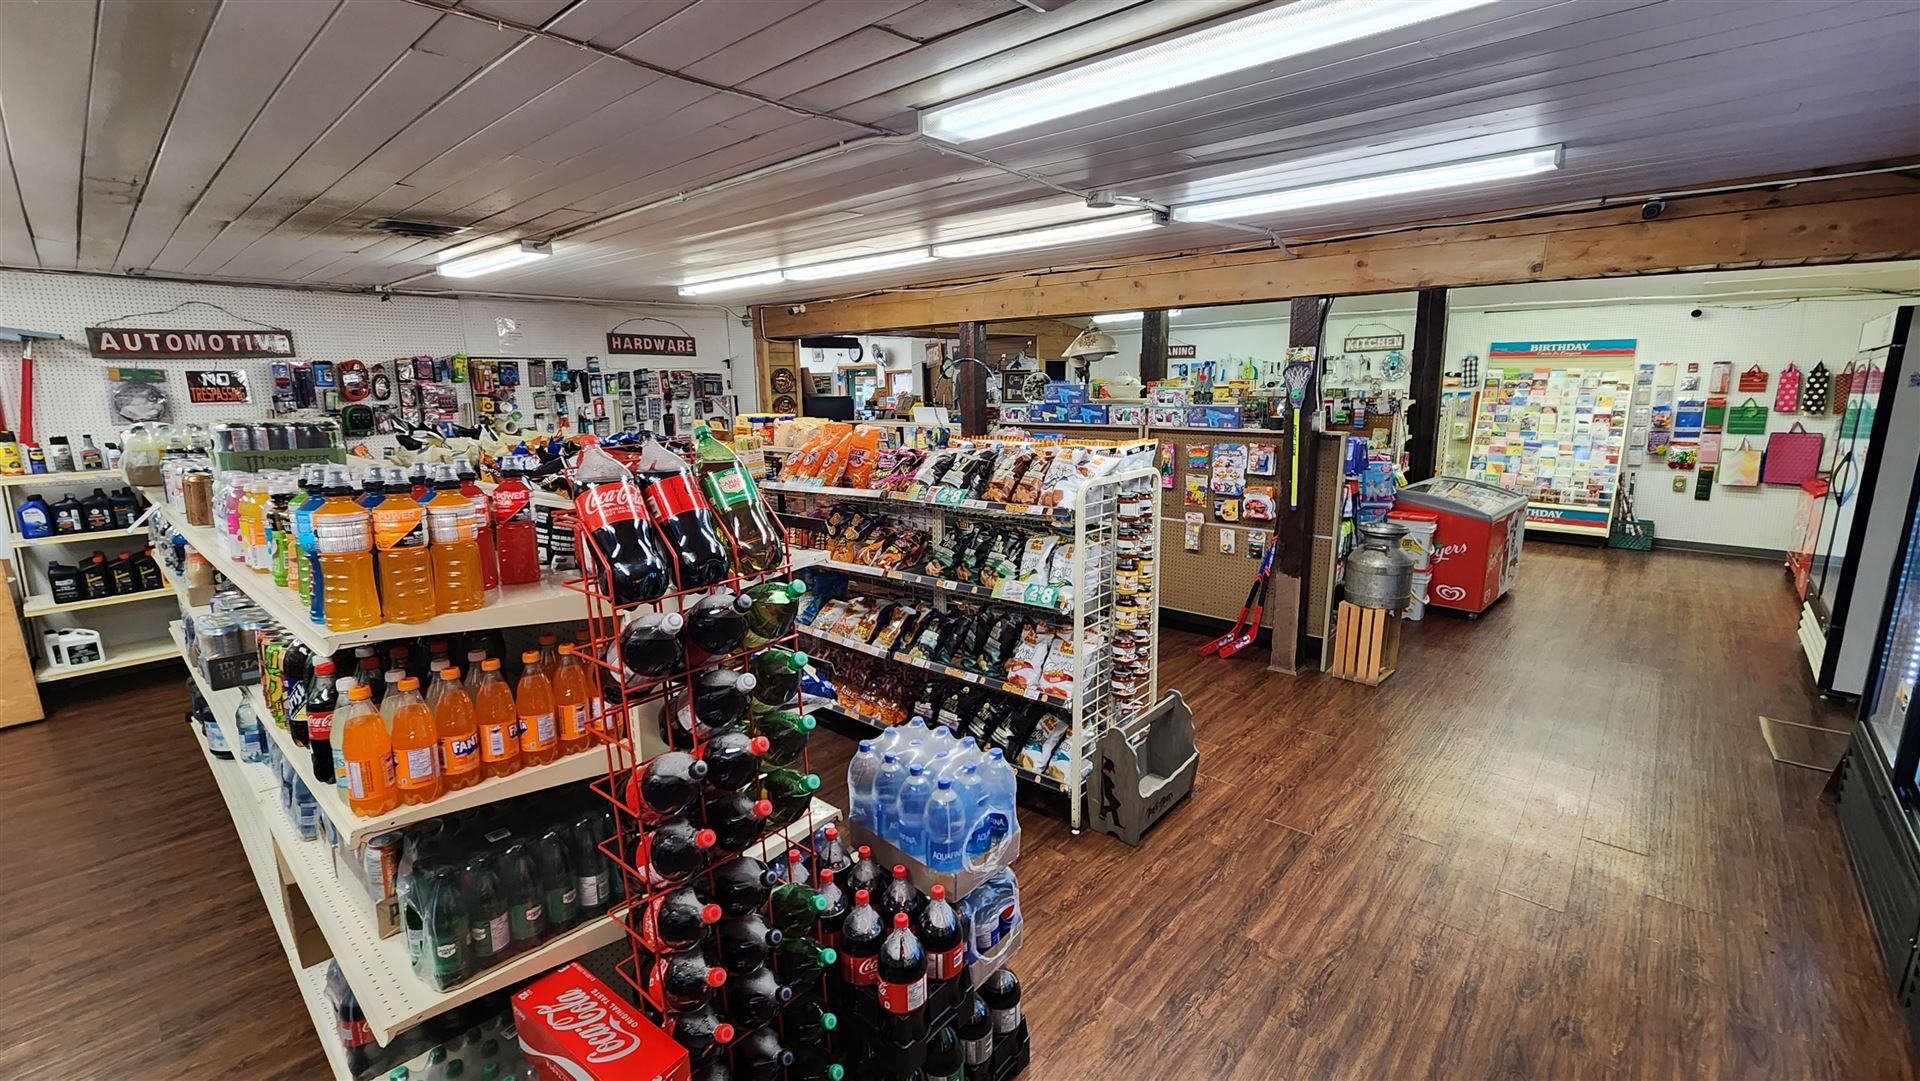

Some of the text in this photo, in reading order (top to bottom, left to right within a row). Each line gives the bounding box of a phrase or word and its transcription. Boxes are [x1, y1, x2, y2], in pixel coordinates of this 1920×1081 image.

[101, 332, 291, 354] AUTOMOTIVE
[612, 337, 694, 352] HARDWARE
[1346, 337, 1402, 351] KITCHEN
[1530, 343, 1591, 352] BIRTHDAY
[1168, 346, 1195, 356] ANING
[202, 372, 230, 386] NO
[190, 386, 246, 401] TRESPASSING
[496, 491, 526, 500] POWER
[378, 511, 415, 520] POWER
[1526, 508, 1563, 519] THDAY
[590, 988, 639, 1028] ORIGINAL TASTE
[534, 987, 641, 1064] Coca-Cola
